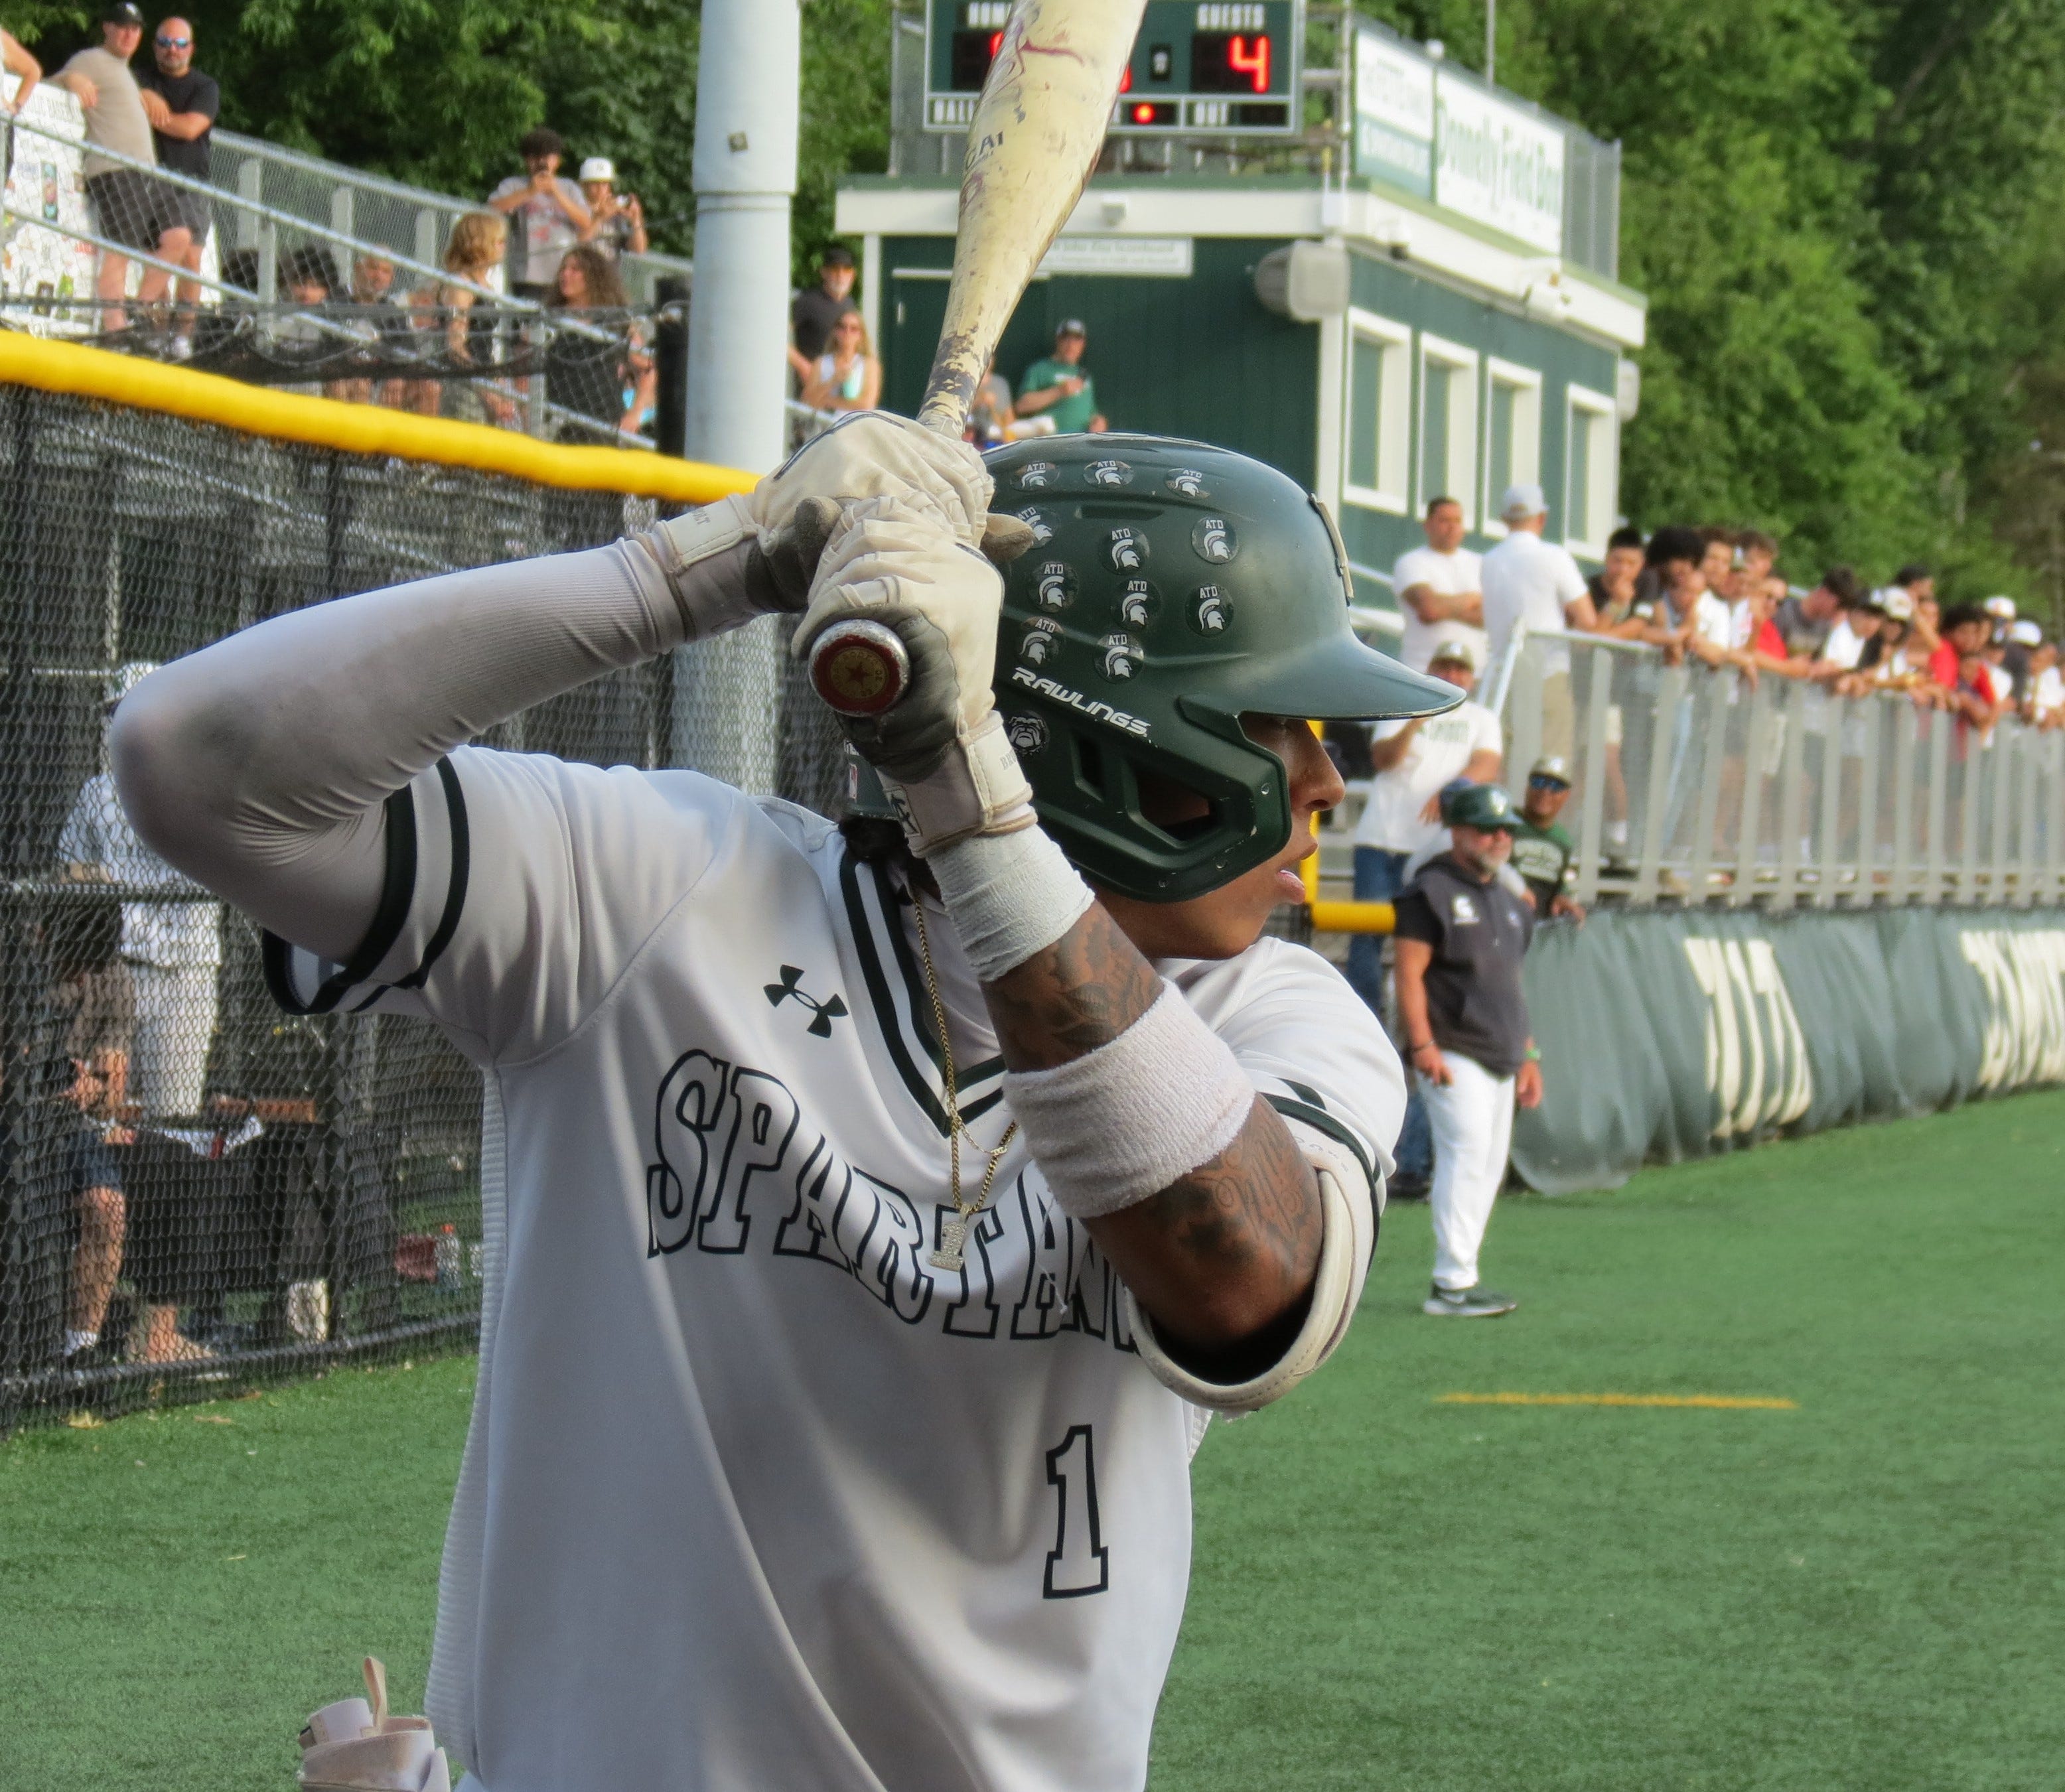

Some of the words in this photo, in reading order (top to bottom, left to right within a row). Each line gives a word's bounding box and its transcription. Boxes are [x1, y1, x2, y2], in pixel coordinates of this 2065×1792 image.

[1228, 35, 1271, 93] 4
[1027, 462, 1046, 472] ATD
[1182, 470, 1202, 478] ATD
[1017, 507, 1037, 521] ATD
[1206, 519, 1224, 529] ATD
[1111, 528, 1131, 540] ATD
[1044, 564, 1064, 575] ATD
[1127, 581, 1147, 591] ATD
[1200, 586, 1218, 598] ATD
[1035, 618, 1056, 633] ATD
[1108, 634, 1127, 646] ATD
[1012, 666, 1151, 736] RAWLINGS
[1043, 1425, 1108, 1600] 1
